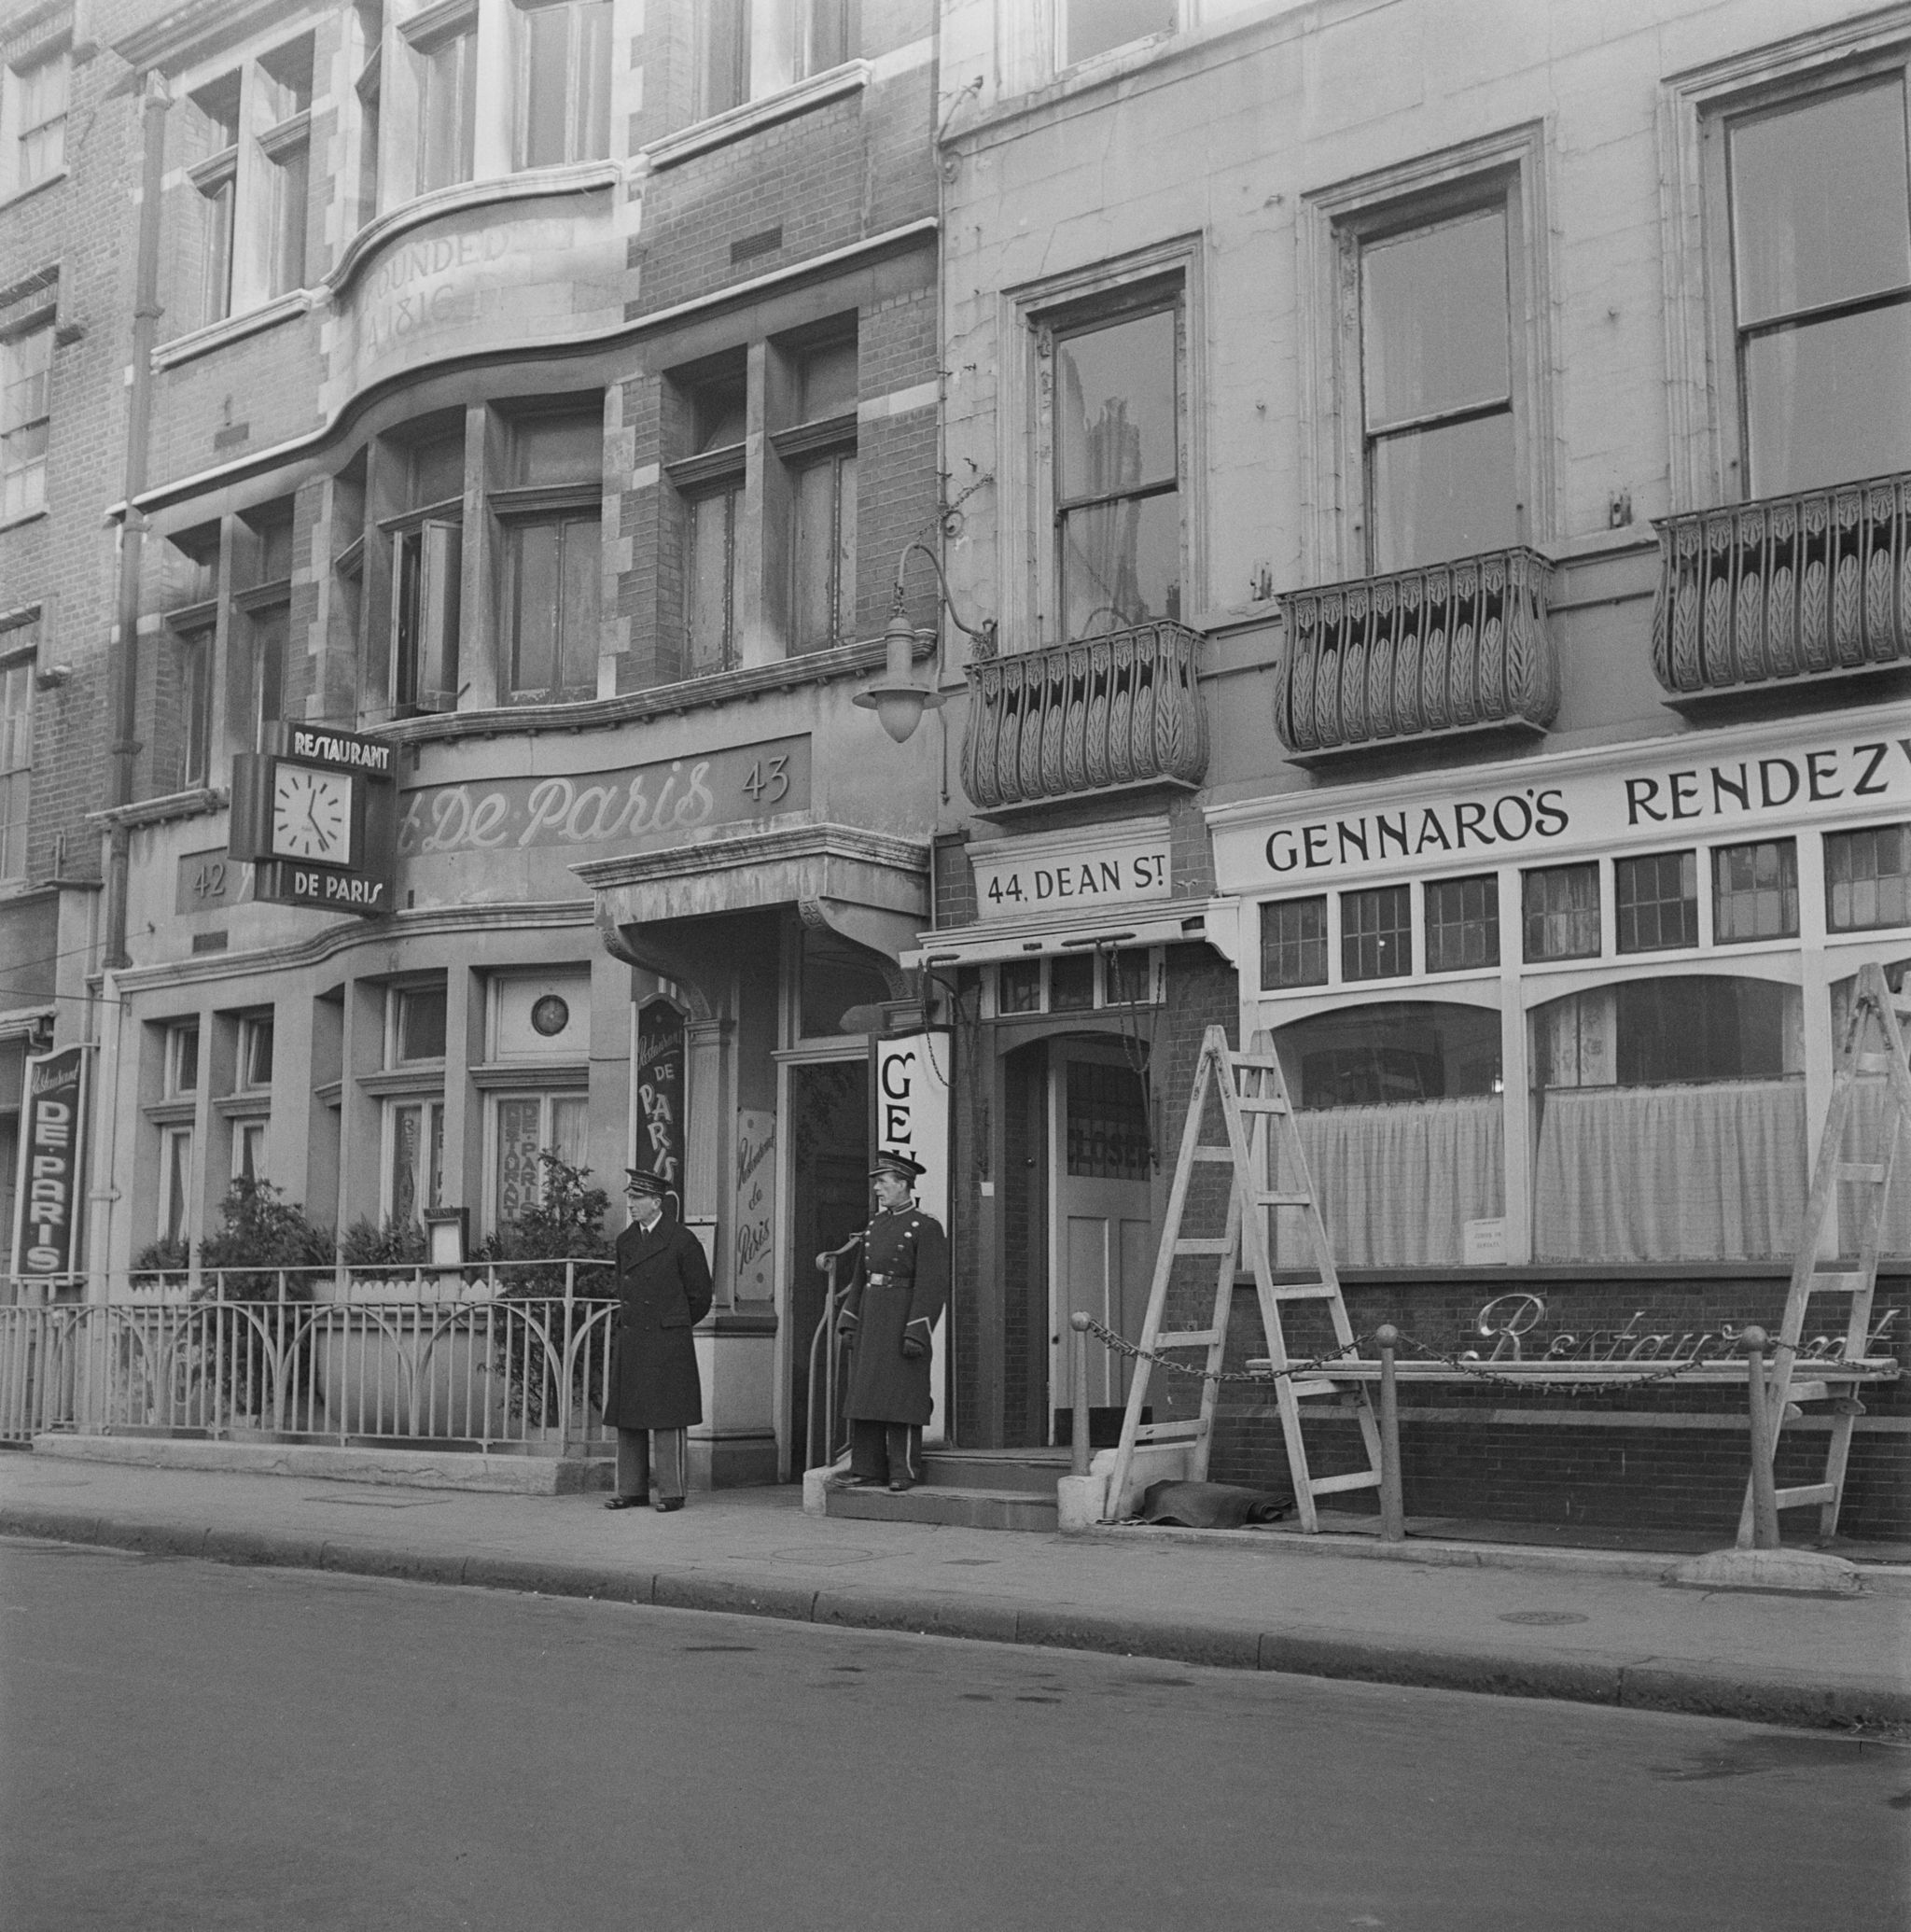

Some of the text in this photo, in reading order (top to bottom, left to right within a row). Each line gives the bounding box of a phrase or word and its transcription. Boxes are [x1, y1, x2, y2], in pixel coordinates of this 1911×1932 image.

[295, 732, 390, 770] RESTAURANT
[742, 754, 789, 804] 43
[422, 786, 509, 853] De
[518, 761, 715, 850] Paris
[1265, 789, 1569, 872] GENNARO'S
[194, 863, 226, 898] 42
[295, 872, 384, 904] DE PARIS
[1034, 861, 1121, 900] DEAN
[654, 1064, 675, 1082] DE
[639, 1084, 678, 1181] PARIS
[26, 1100, 71, 1271] DE PARIS
[749, 1182, 763, 1211] de
[738, 1217, 771, 1276] Paris
